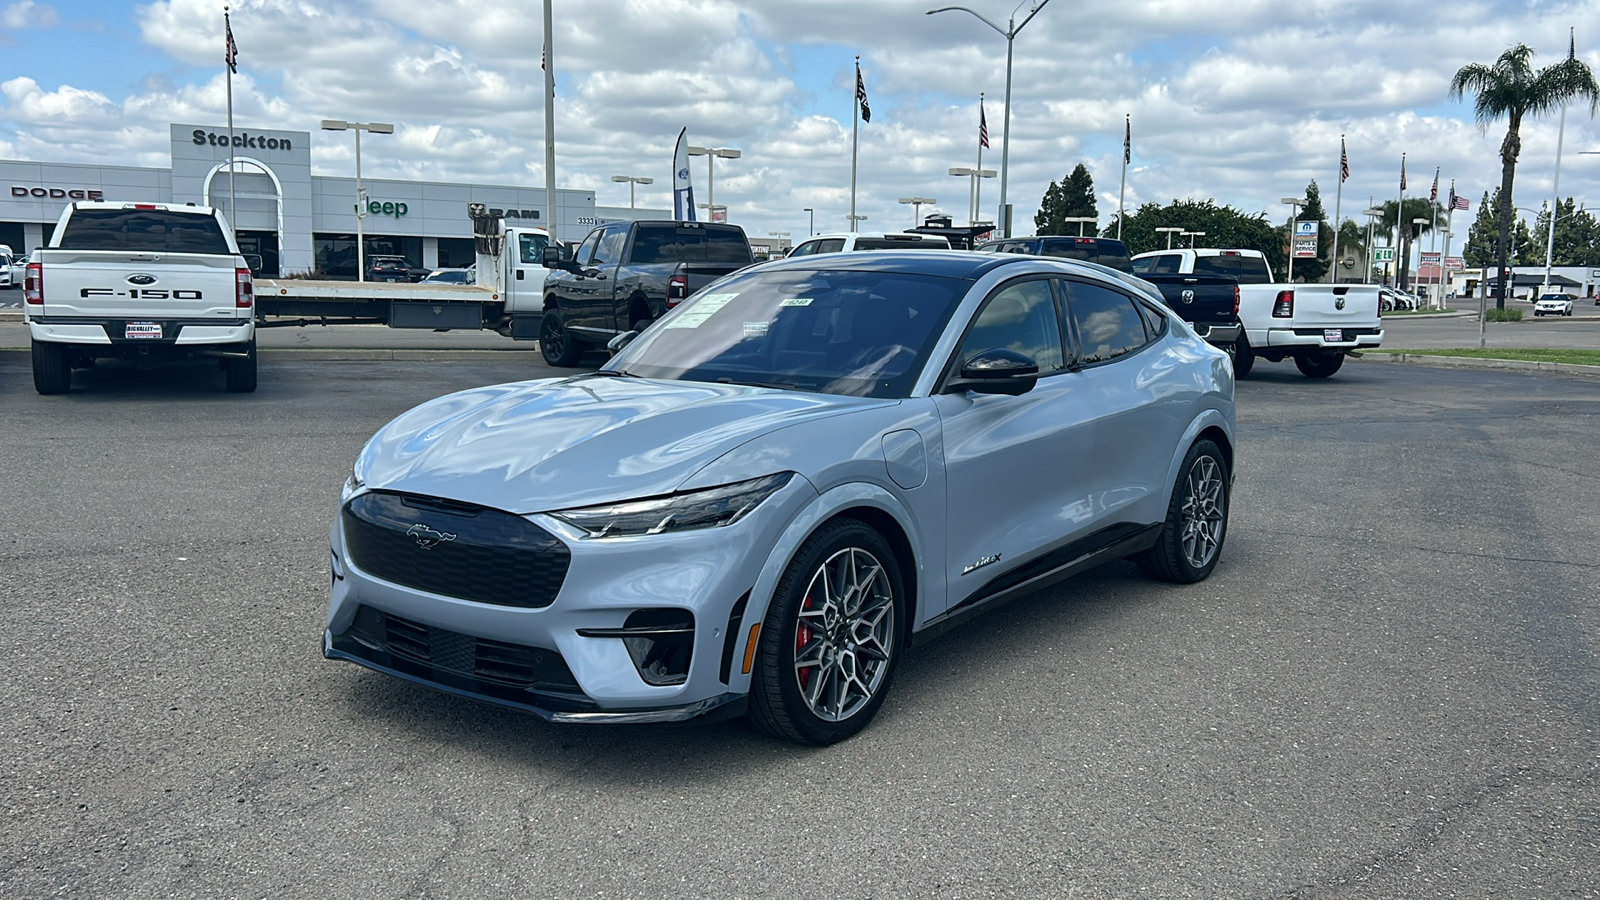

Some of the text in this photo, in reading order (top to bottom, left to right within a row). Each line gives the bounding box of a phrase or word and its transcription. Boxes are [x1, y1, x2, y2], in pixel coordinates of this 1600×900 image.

[192, 129, 292, 151] Stockton
[11, 186, 103, 200] DODGE
[489, 208, 540, 219] RAM
[577, 217, 595, 225] 3333
[80, 288, 203, 300] F-150
